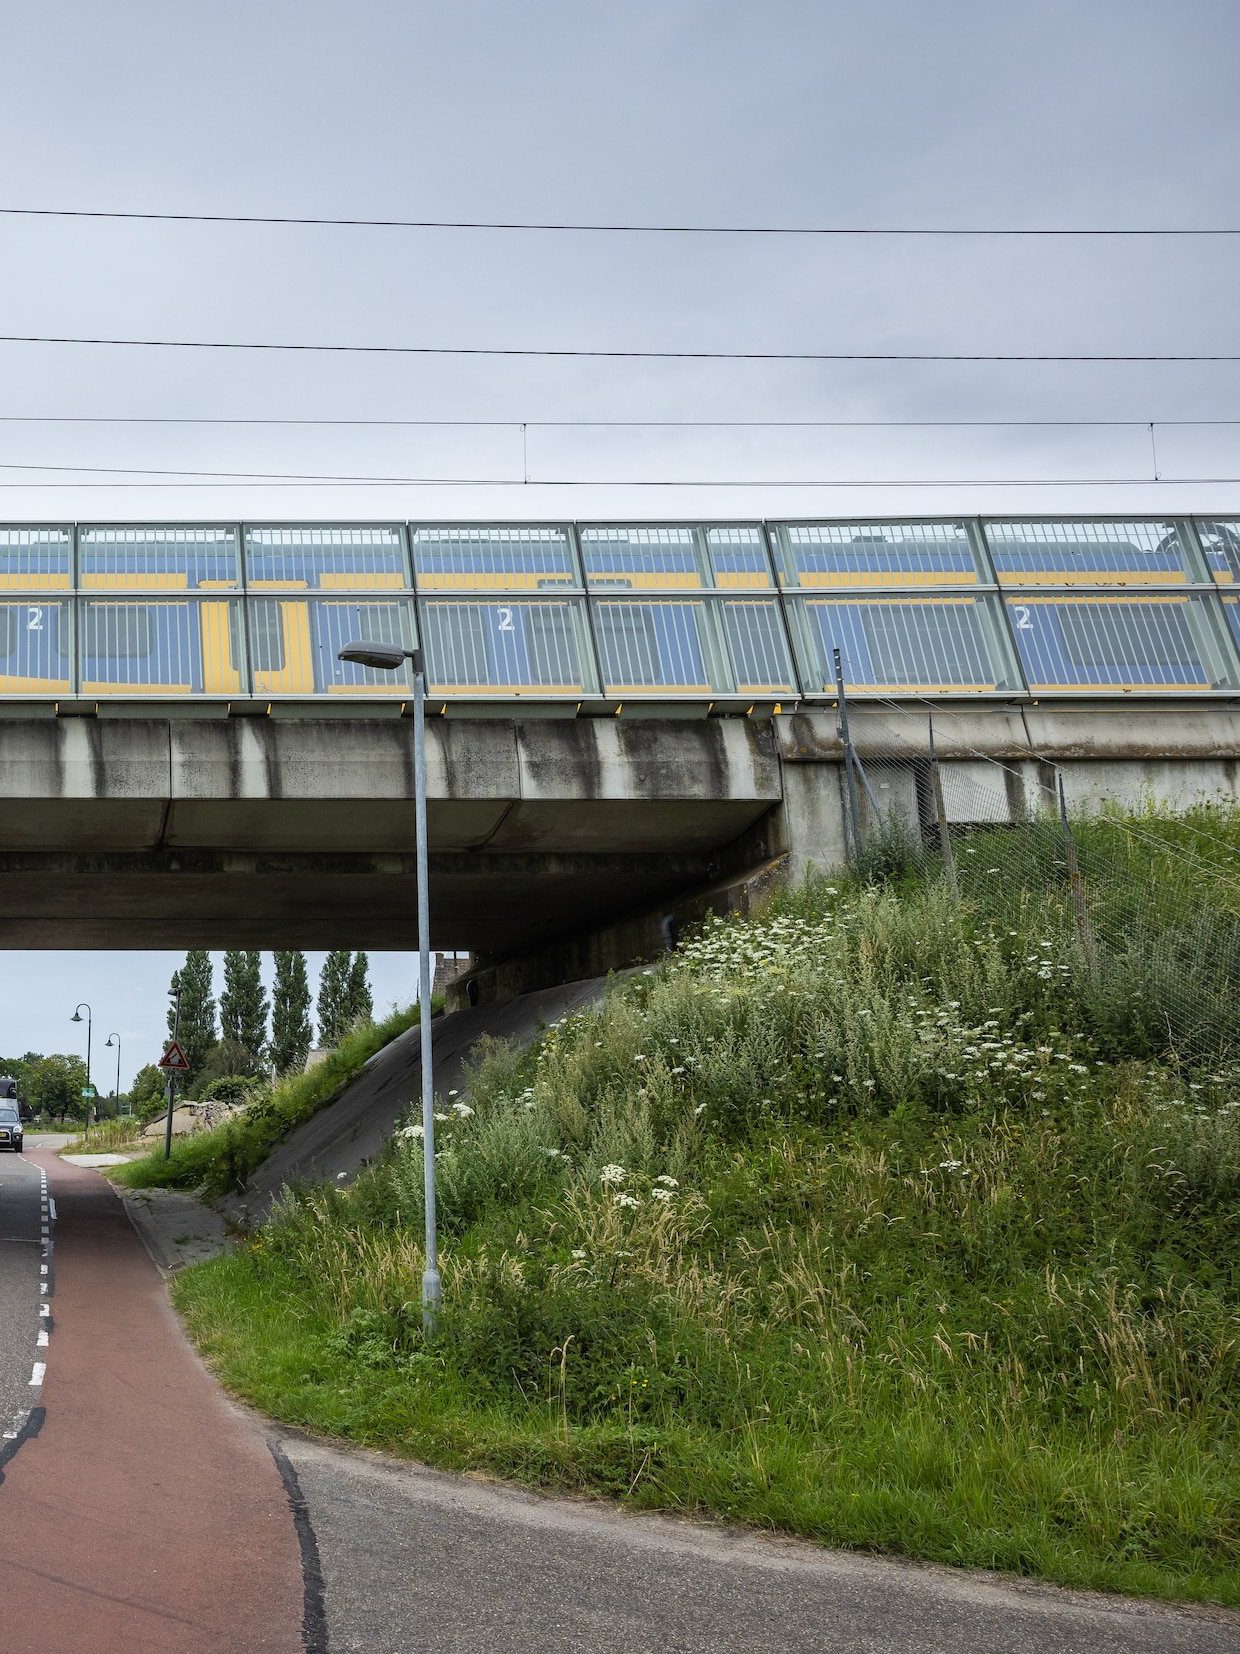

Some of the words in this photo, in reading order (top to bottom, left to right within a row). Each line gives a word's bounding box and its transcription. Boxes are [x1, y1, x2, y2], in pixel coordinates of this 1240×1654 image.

[27, 607, 43, 629] 2
[497, 608, 515, 630] 2
[1014, 606, 1033, 628] 2
